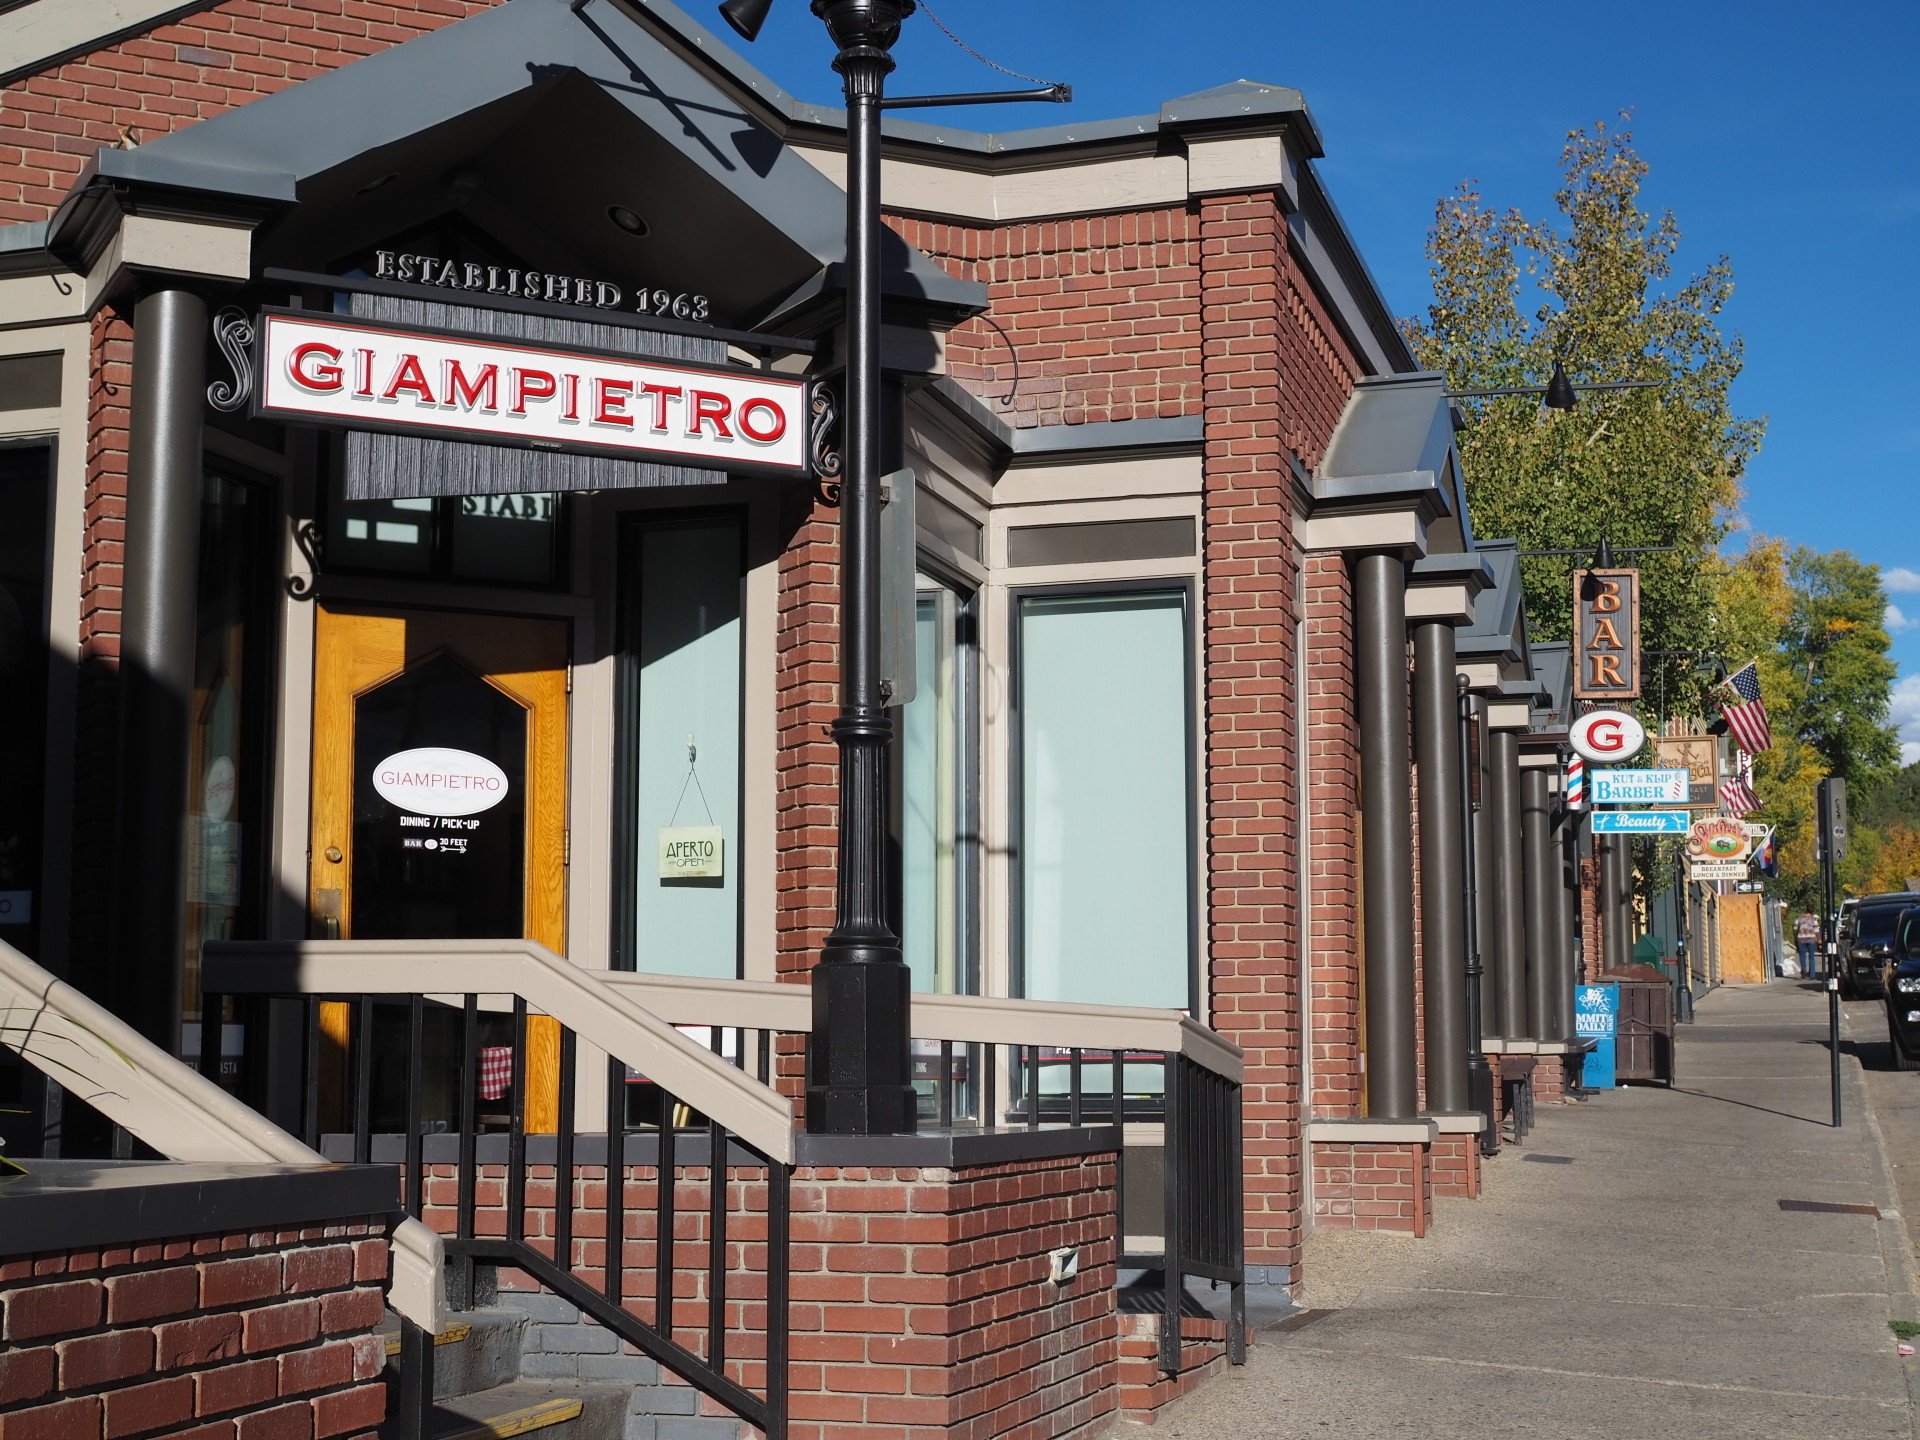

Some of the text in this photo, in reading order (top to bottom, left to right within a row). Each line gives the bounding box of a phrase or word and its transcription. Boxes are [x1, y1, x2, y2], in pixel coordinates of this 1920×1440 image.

[375, 250, 710, 322] ESTABLISHED 1963
[286, 340, 788, 444] GIAMPIETRO
[1587, 581, 1626, 688] BAR
[1585, 718, 1625, 752] G
[381, 771, 500, 791] GIAMPIETRO
[1597, 780, 1665, 800] BARBER
[400, 816, 430, 828] DINING
[441, 819, 480, 830] PICK-UP
[1615, 814, 1667, 831] Beauty
[440, 838, 468, 846] 30 FEET
[666, 841, 713, 858] APERTO
[676, 858, 704, 867] OPEN
[1576, 1022, 1606, 1031] DAILY
[220, 1061, 238, 1075] ASTA
